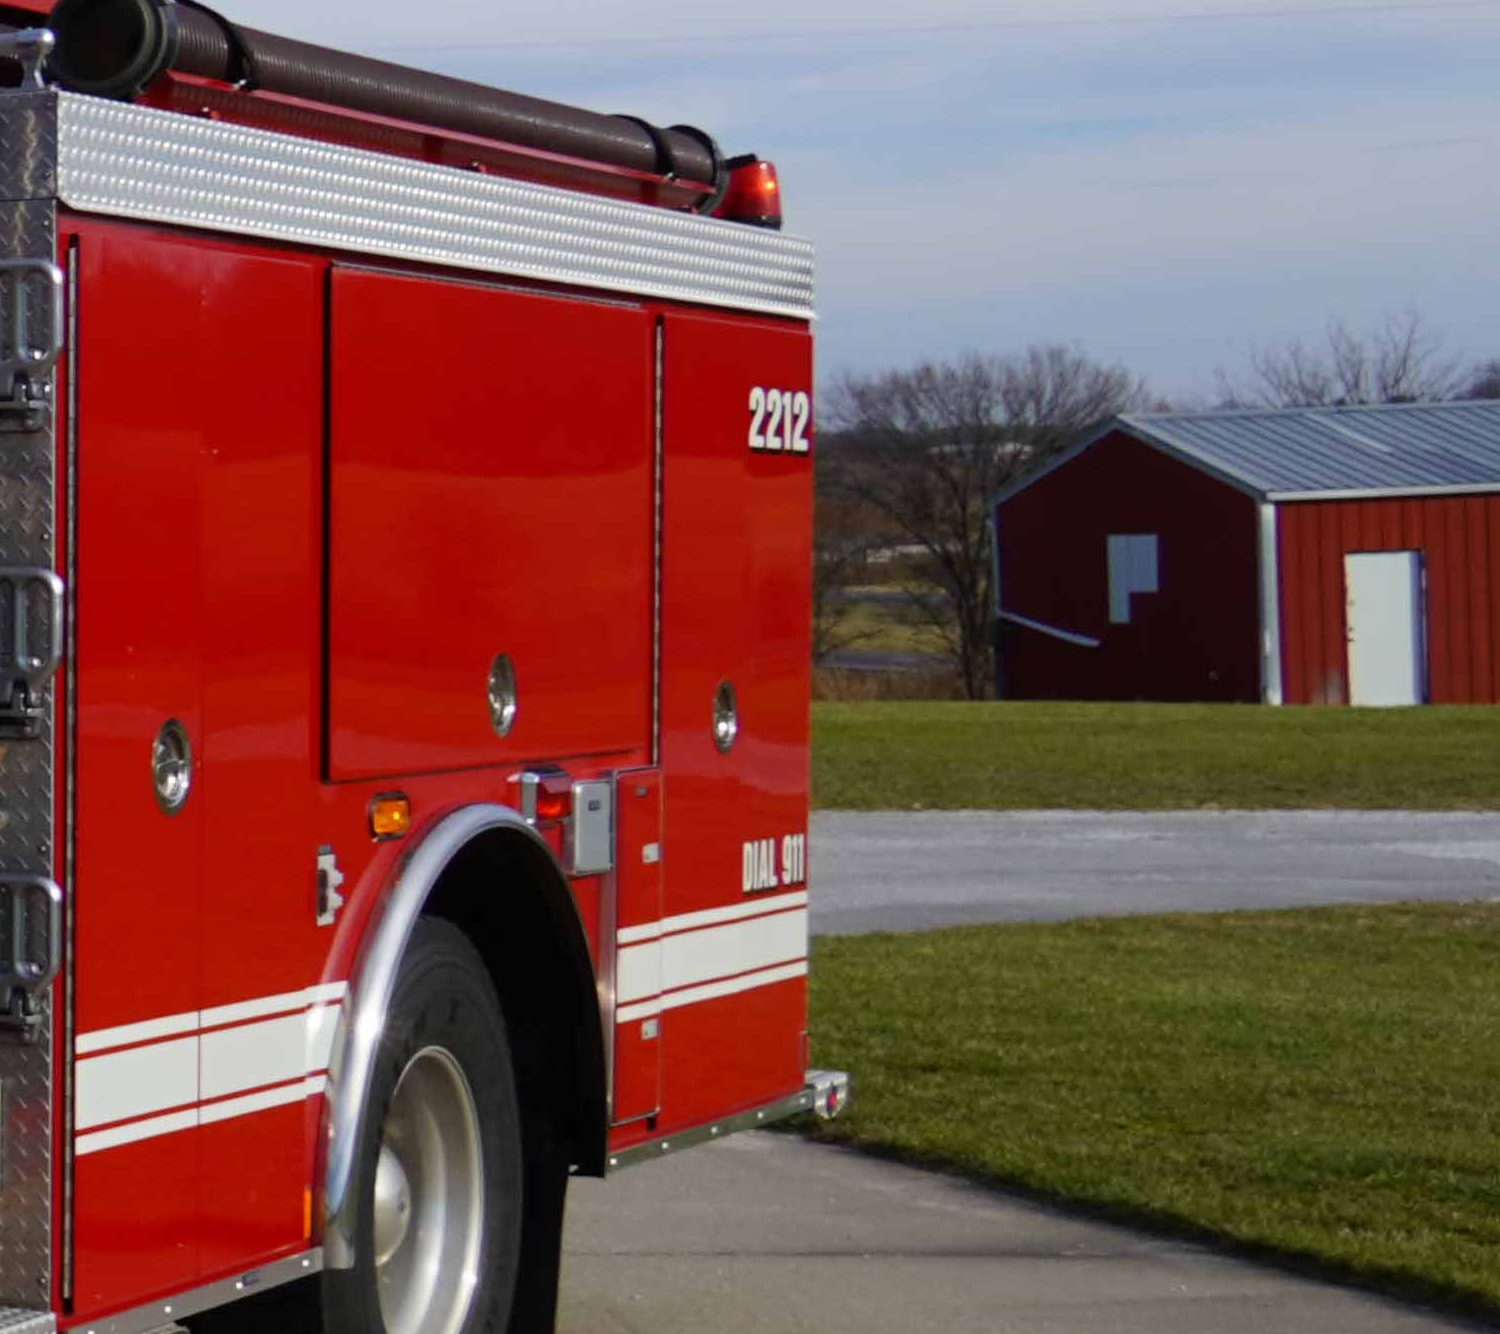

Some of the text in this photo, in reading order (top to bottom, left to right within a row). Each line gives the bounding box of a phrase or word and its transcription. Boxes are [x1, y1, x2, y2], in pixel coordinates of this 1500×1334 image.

[748, 386, 809, 452] 2212
[742, 834, 804, 892] DIAL 911
